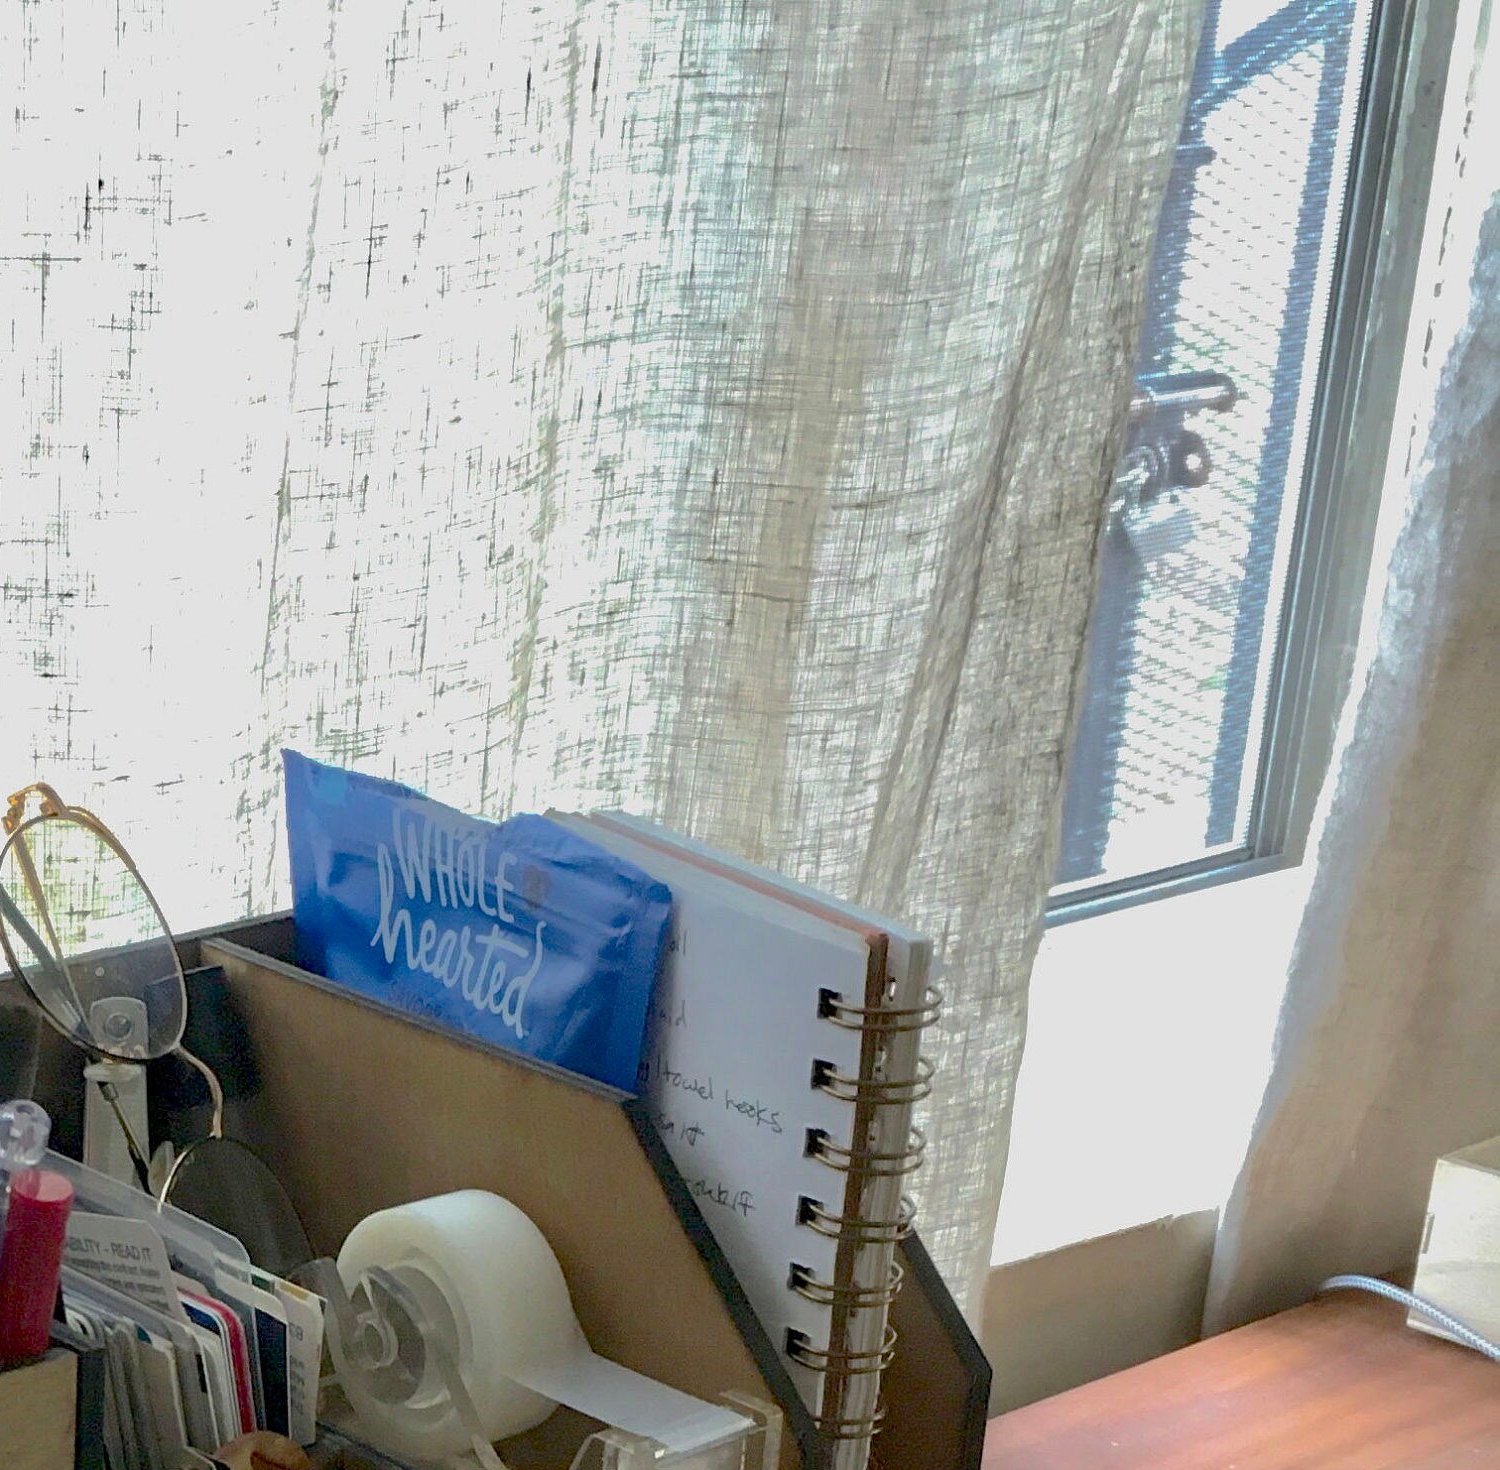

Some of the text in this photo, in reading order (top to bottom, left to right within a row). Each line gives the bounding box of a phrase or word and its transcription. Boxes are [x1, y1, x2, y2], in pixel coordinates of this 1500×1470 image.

[392, 806, 518, 923] WHOLE
[370, 842, 547, 1040] hearted
[662, 1060, 714, 1101] towel
[109, 1242, 140, 1261] READ
[140, 1246, 153, 1263] IT
